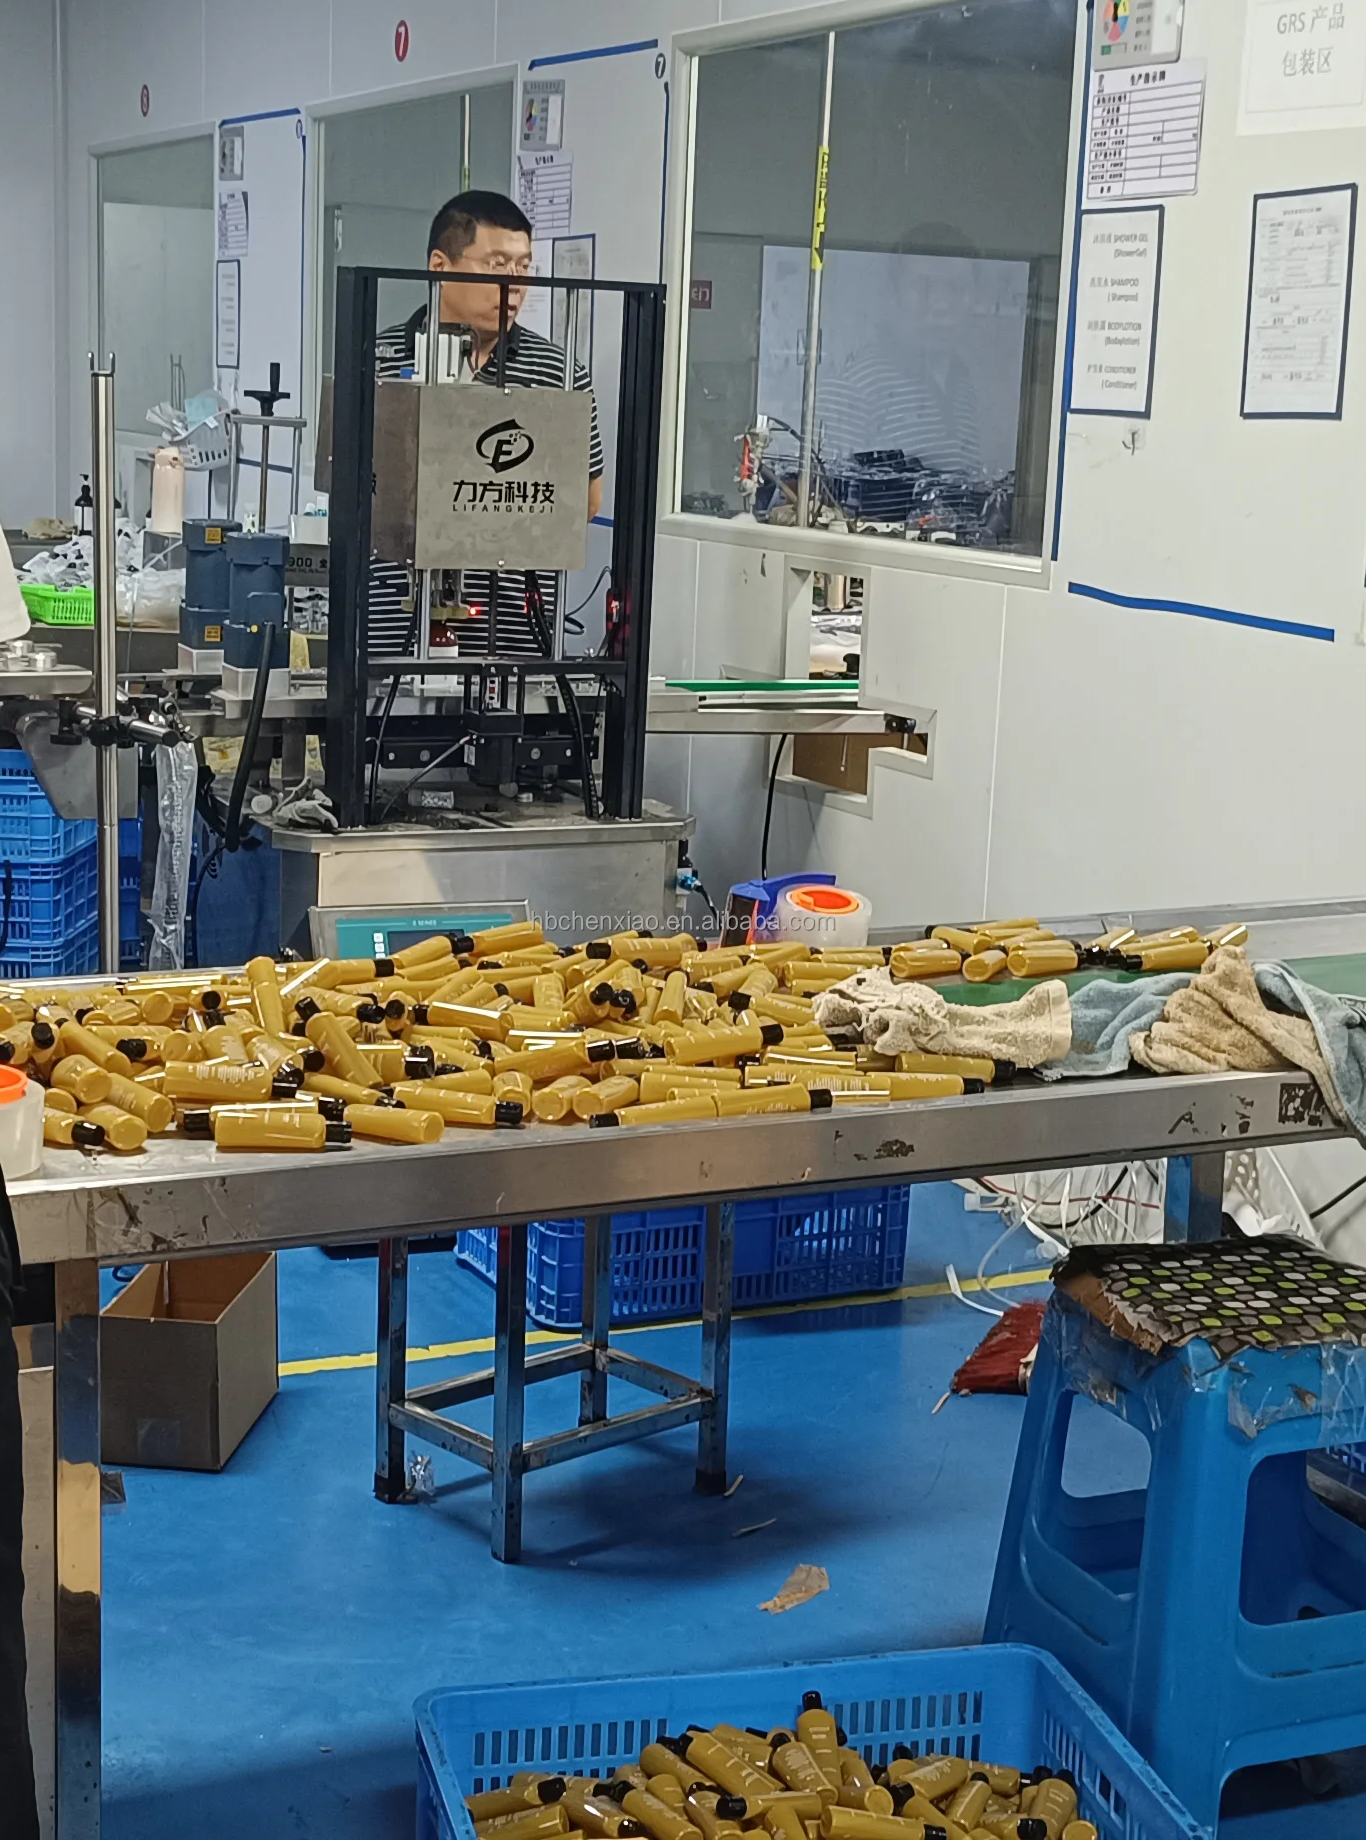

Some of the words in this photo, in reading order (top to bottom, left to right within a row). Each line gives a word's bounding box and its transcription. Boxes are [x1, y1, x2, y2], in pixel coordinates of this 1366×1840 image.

[1277, 11, 1306, 35] GRS
[1310, 2, 1345, 33] 产品
[397, 26, 406, 57] 7
[1282, 46, 1334, 77] 包装区
[453, 480, 555, 504] 力方科技
